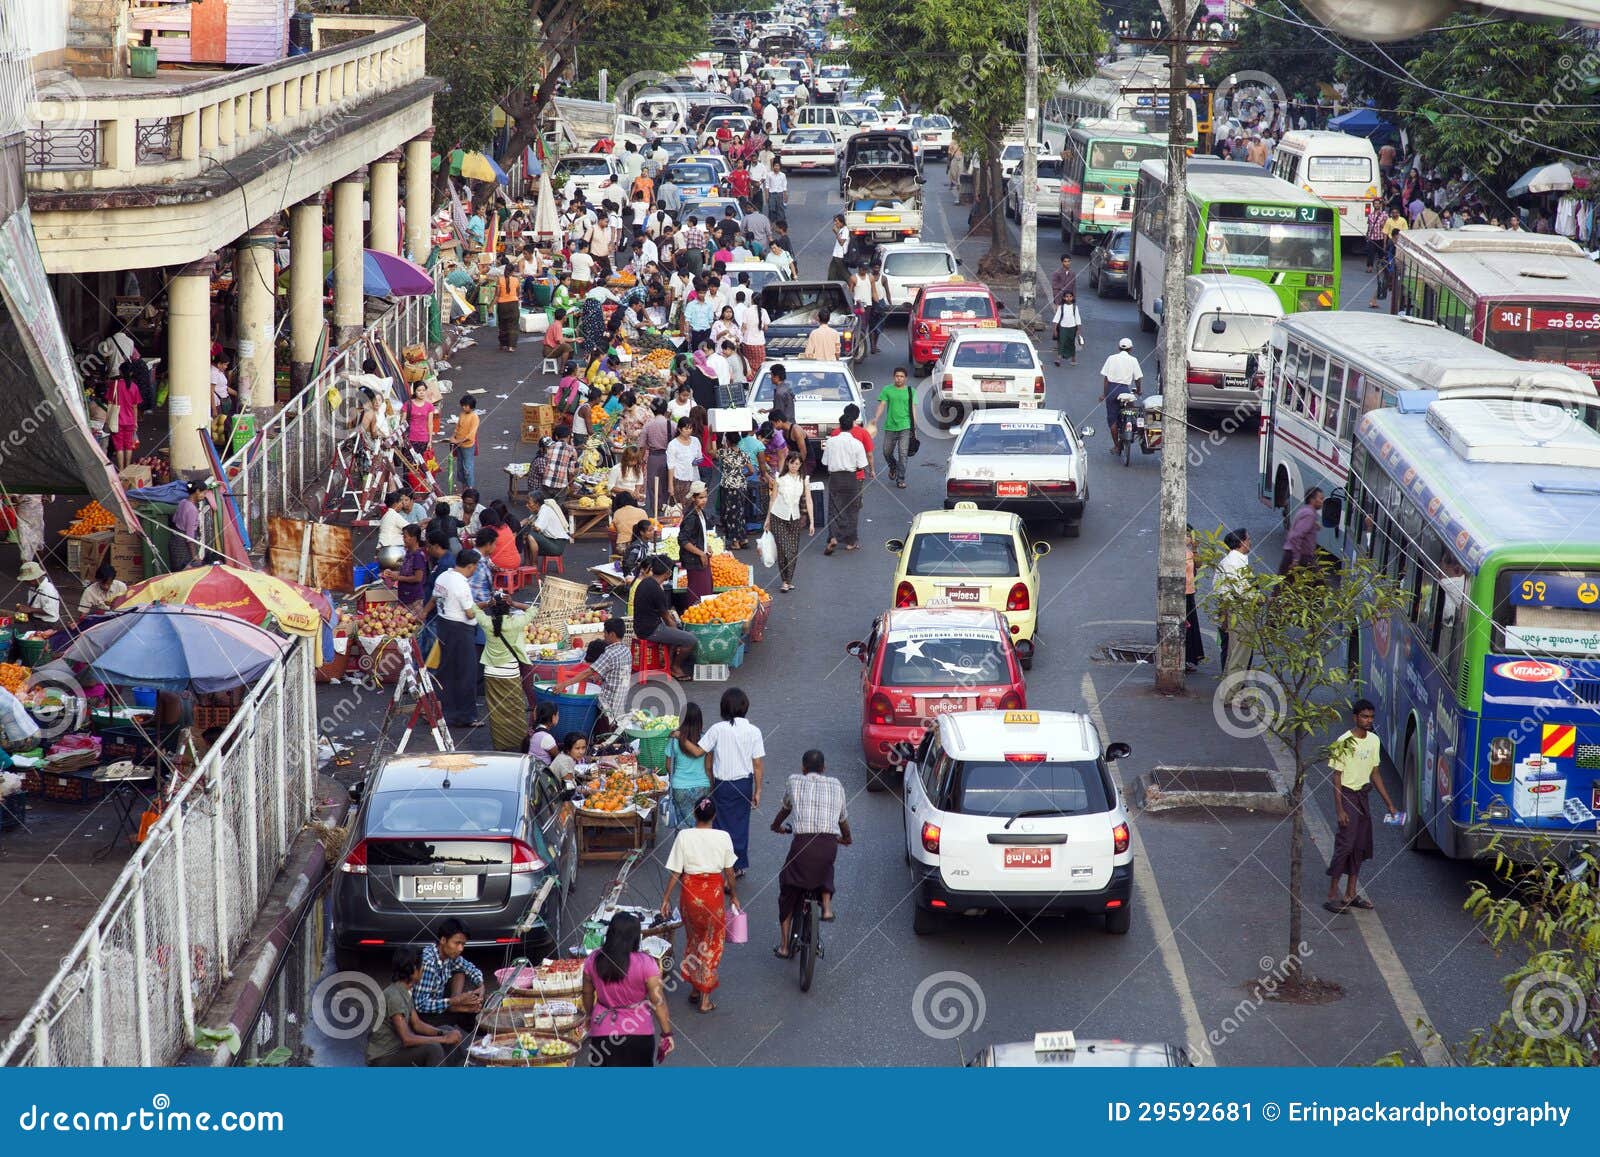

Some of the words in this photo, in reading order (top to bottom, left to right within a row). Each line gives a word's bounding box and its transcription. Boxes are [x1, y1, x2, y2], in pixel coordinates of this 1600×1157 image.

[957, 503, 976, 511] TAXI
[930, 597, 950, 606] TAXI
[1513, 665, 1554, 677] VITACAP
[1009, 713, 1034, 722] TAXI
[1041, 1036, 1069, 1046] TAXI
